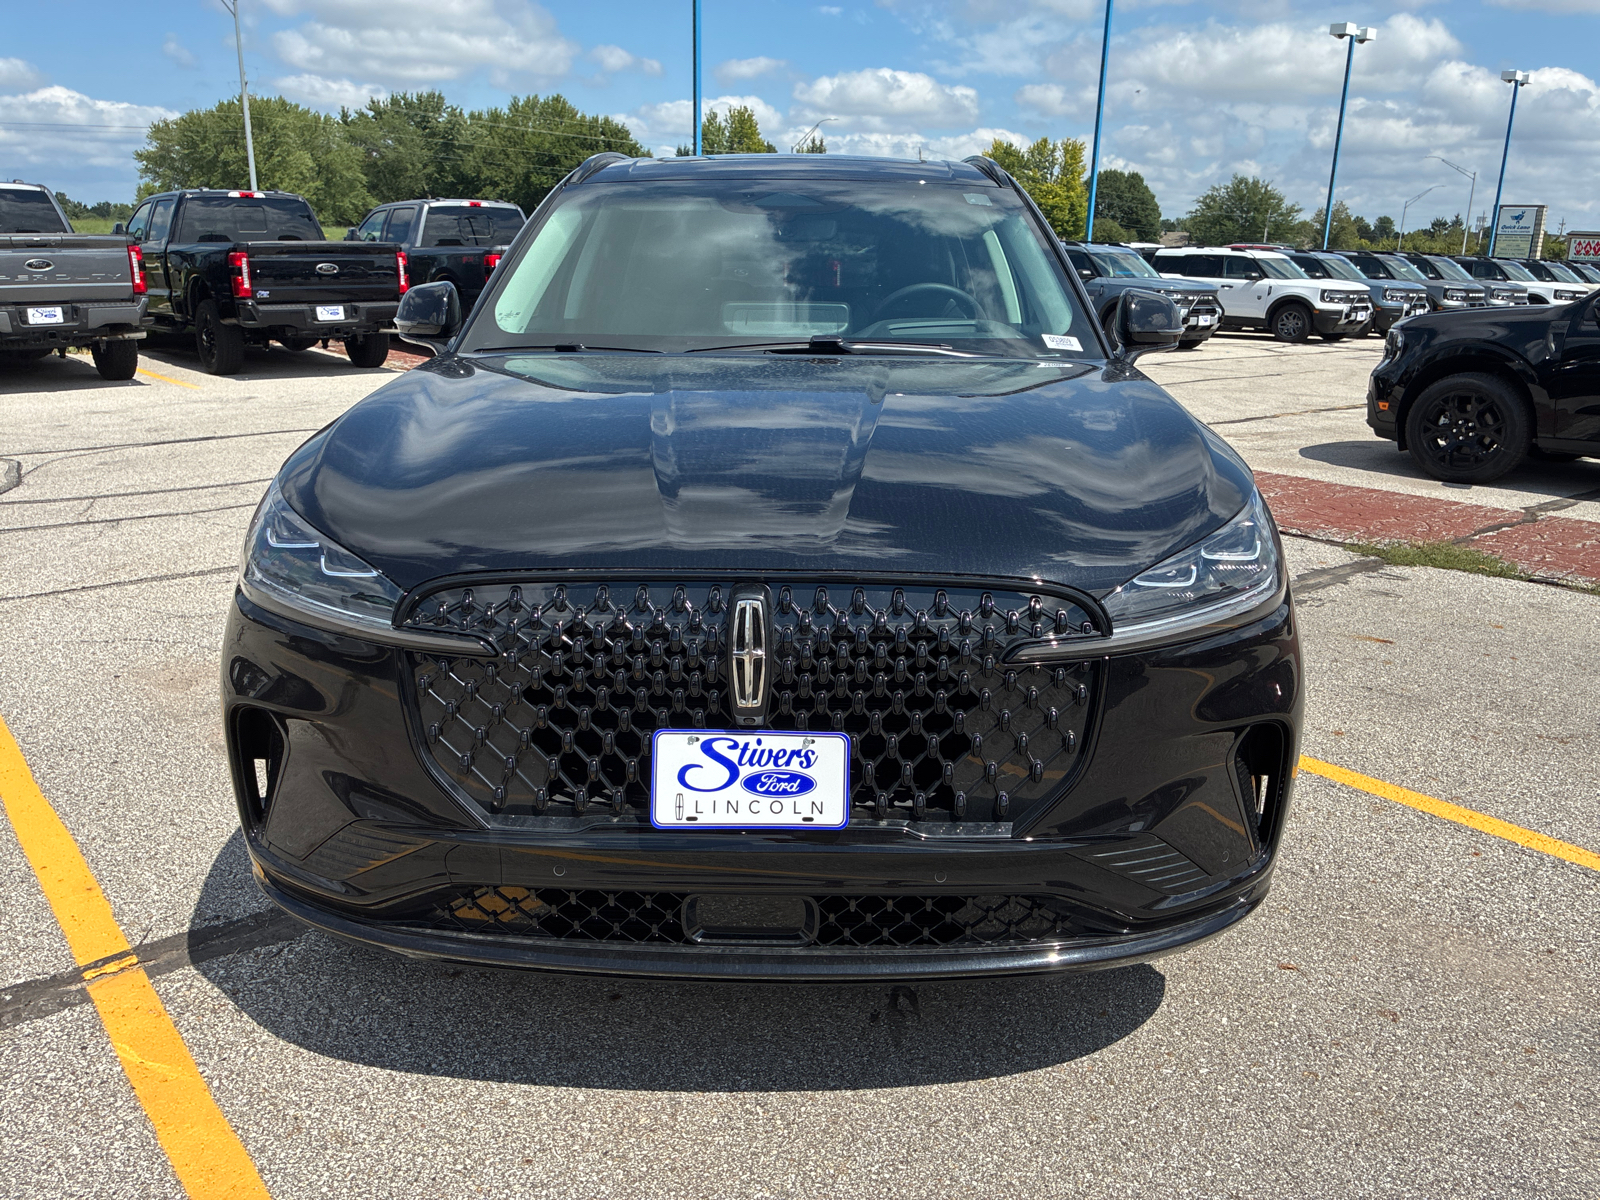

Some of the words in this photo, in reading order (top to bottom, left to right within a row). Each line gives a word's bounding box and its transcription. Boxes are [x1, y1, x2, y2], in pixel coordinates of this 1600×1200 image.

[677, 737, 818, 792] Stivers
[756, 773, 801, 792] Ford
[695, 800, 823, 814] LINCOLN
